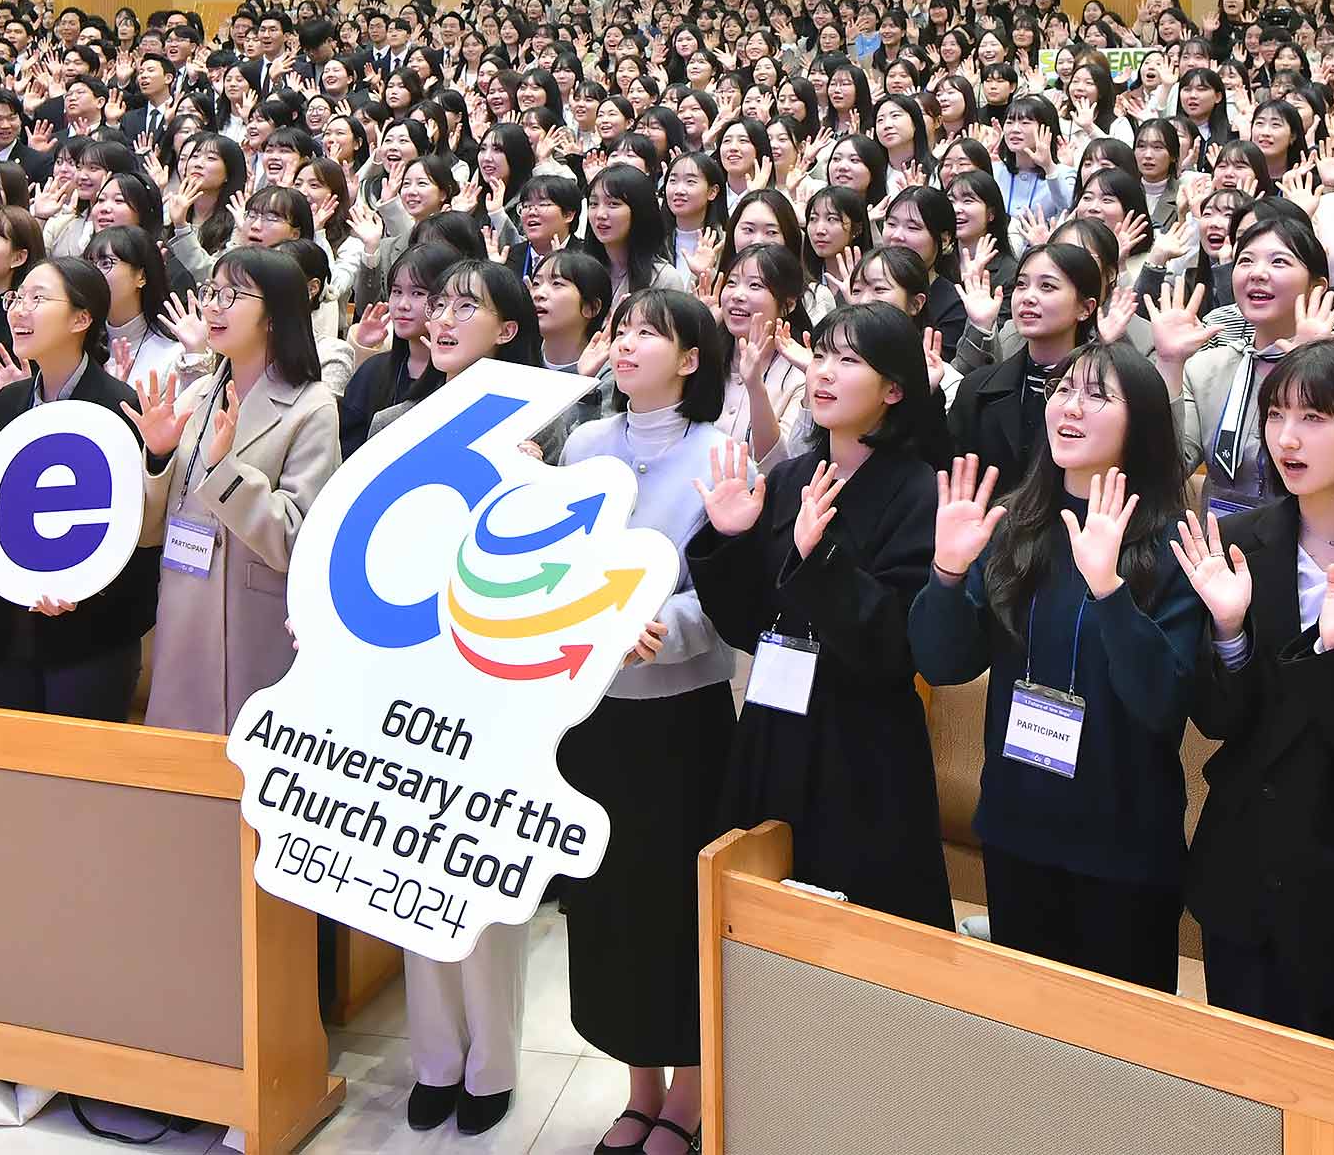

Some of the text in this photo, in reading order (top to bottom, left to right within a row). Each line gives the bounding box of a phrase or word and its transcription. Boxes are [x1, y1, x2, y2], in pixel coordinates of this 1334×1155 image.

[381, 699, 474, 761] 60th
[1017, 719, 1071, 742] PARTICIPANT
[244, 709, 587, 856] Anniversary of the
[258, 766, 534, 898] Church of God
